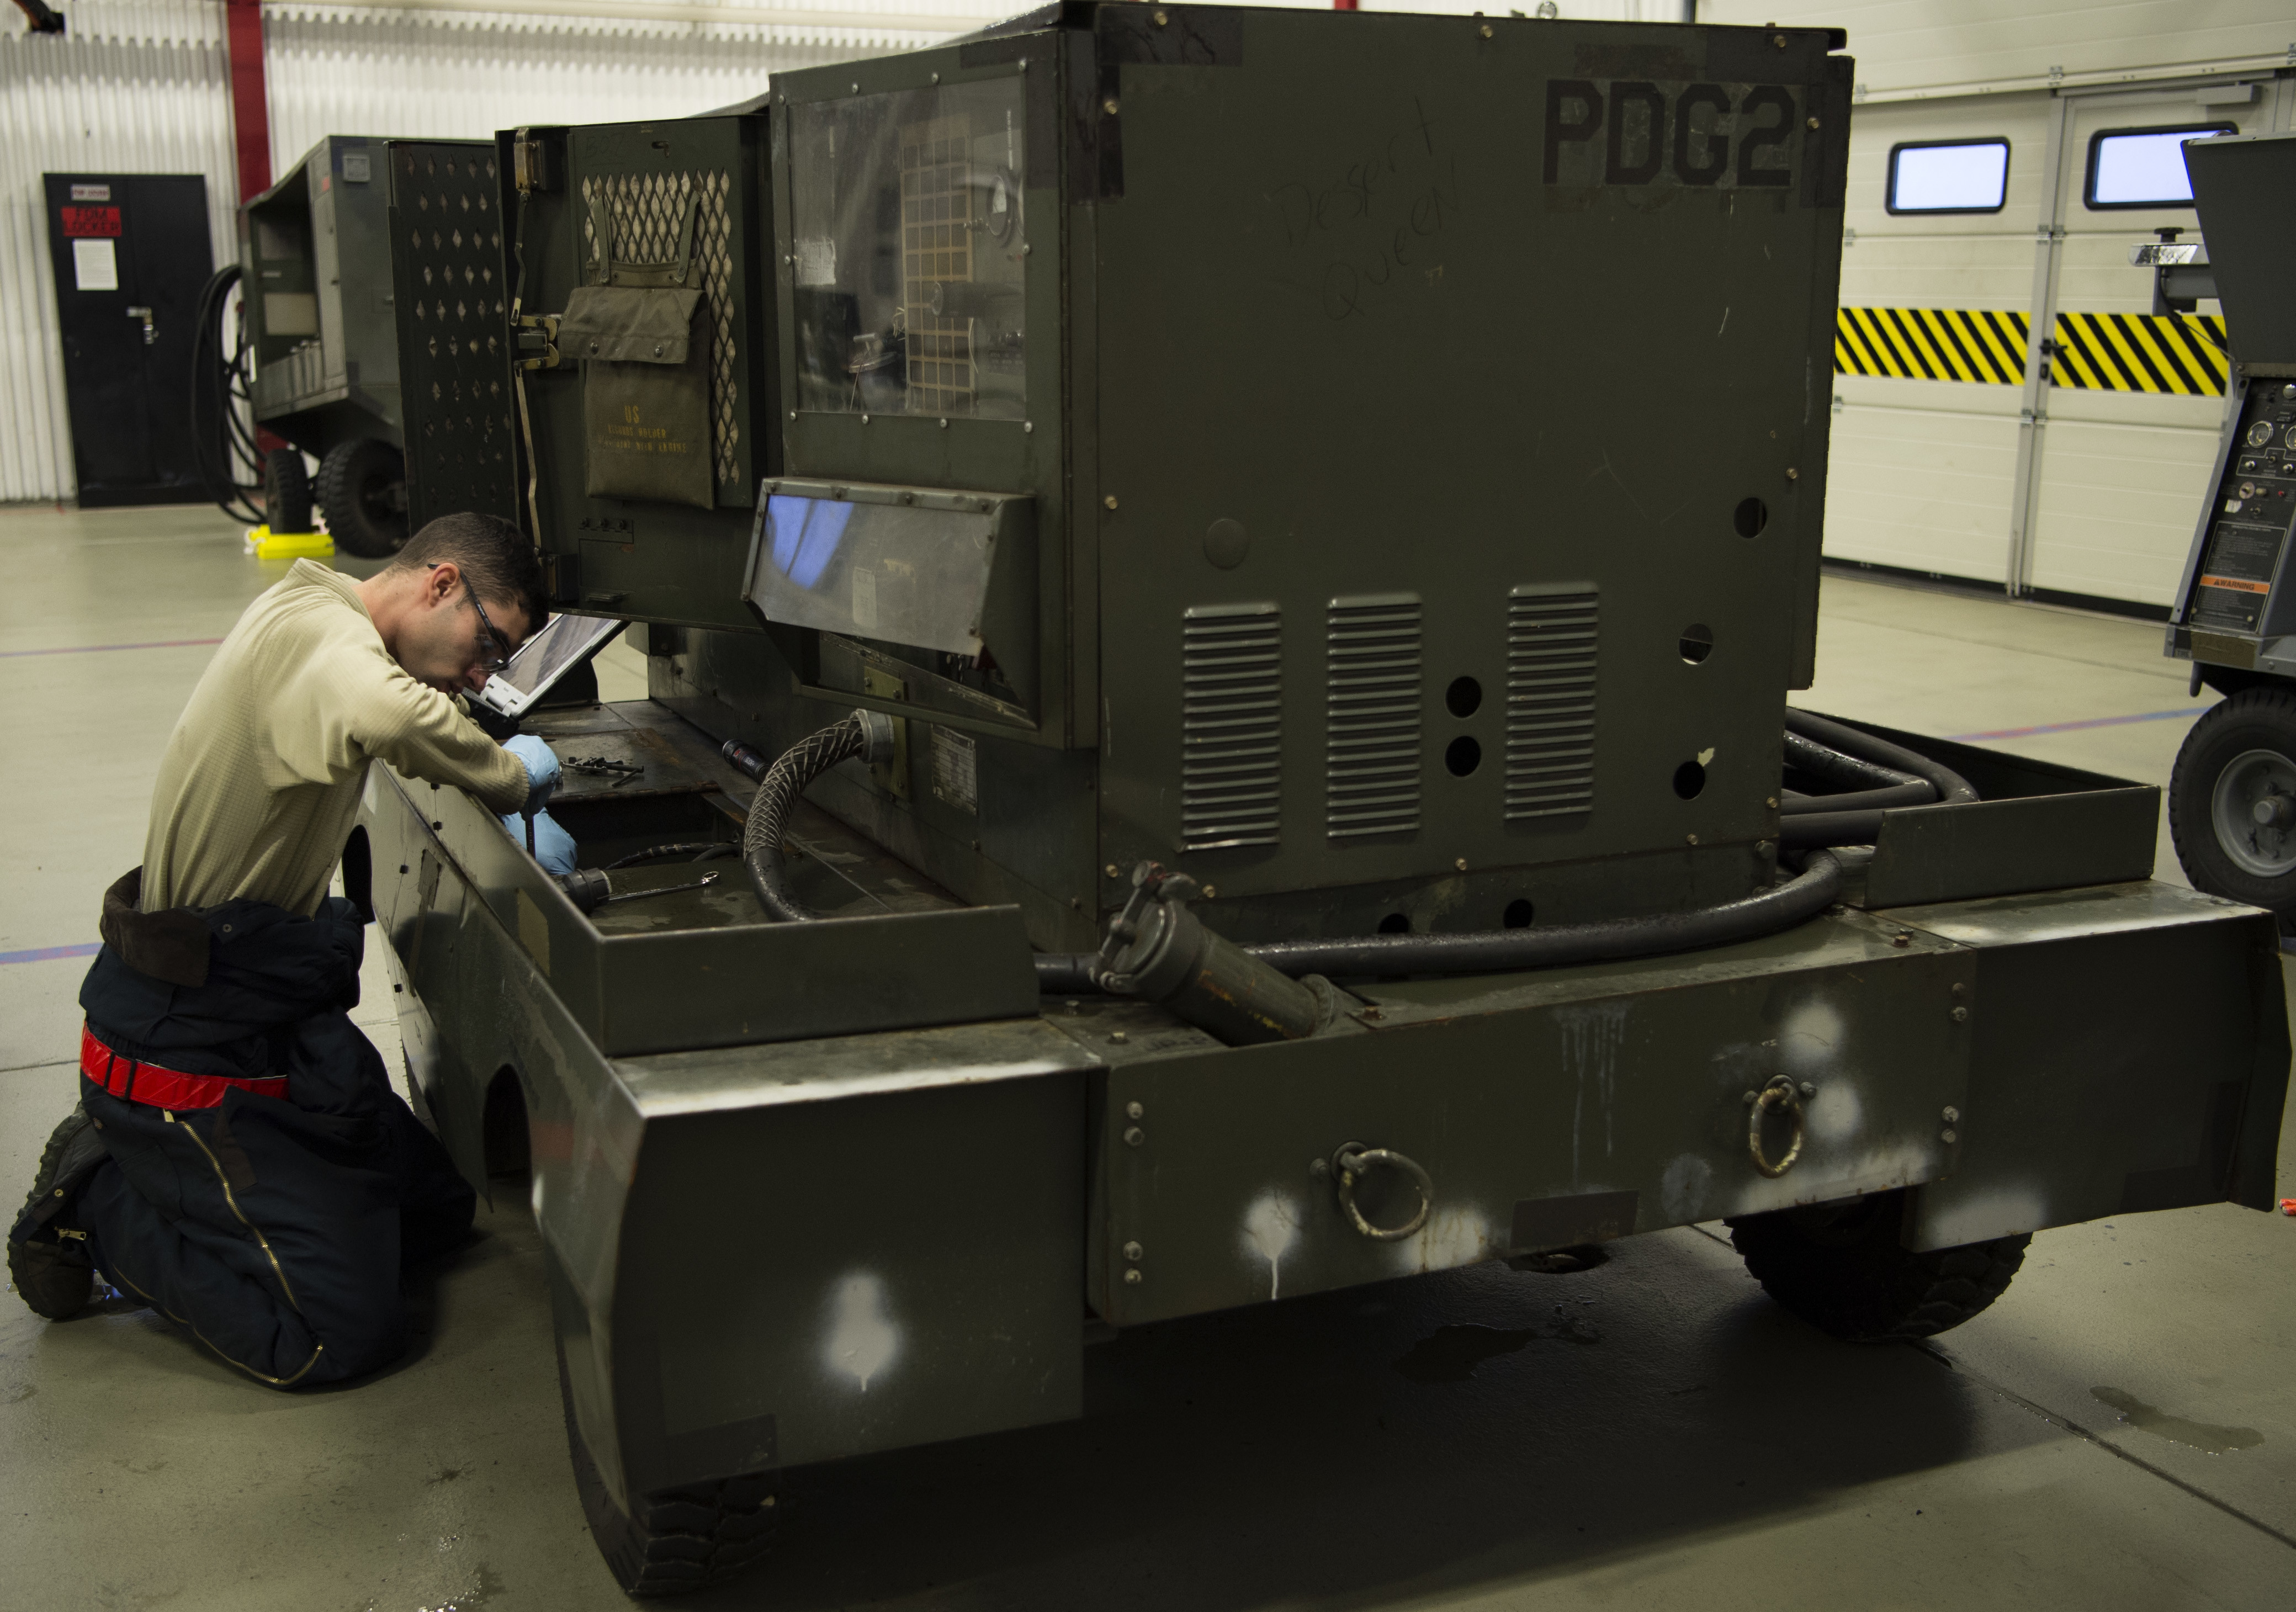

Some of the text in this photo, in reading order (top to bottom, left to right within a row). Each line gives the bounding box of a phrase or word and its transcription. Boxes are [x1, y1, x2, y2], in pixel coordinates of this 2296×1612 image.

[1542, 78, 1795, 187] PDG2
[624, 405, 640, 423] US
[2219, 579, 2255, 591] WARNING
